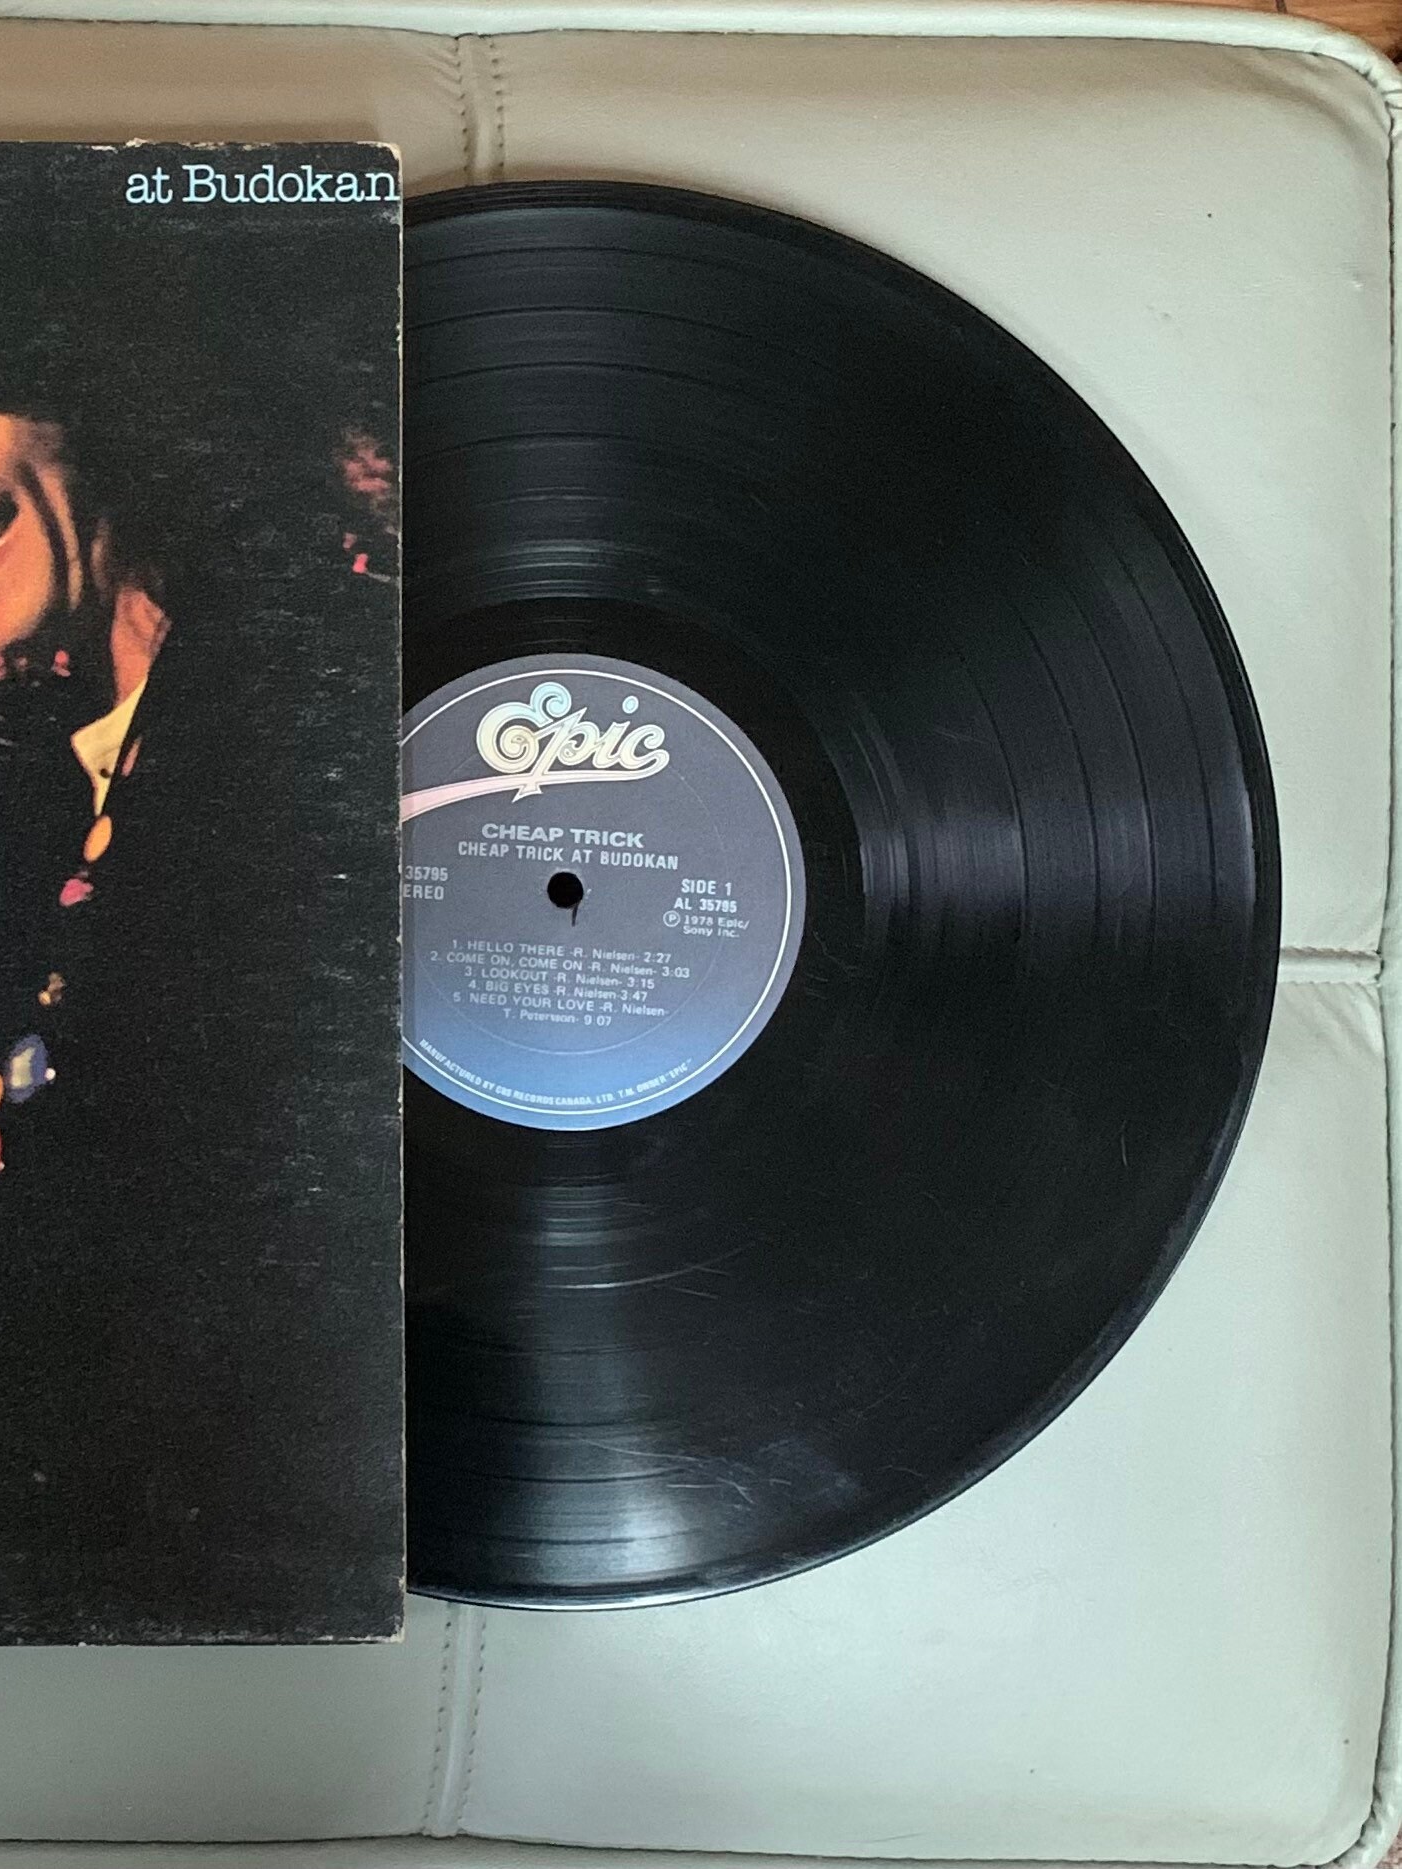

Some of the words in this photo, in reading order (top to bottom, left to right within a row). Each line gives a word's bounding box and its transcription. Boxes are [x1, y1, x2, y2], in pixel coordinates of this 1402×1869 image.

[125, 166, 174, 204] at
[181, 163, 401, 204] Budokan
[475, 681, 670, 803] Epic
[481, 822, 564, 842] CHEAP
[569, 827, 644, 848] TRICK
[458, 840, 509, 858] CHEAP
[515, 844, 564, 862] TRICK
[571, 848, 593, 864] AT
[600, 851, 679, 870] BUDOKAN
[404, 865, 449, 882] 35795
[681, 878, 717, 895] SIDE
[725, 882, 732, 896] 1
[674, 897, 693, 911] AL
[699, 898, 738, 914] 35795
[684, 914, 714, 927] 1978
[683, 925, 714, 937] Sony
[717, 928, 740, 938] Inc.
[467, 940, 514, 953] HELLO
[519, 943, 565, 957] THERE
[643, 951, 672, 964] 2:27
[446, 951, 486, 965] COME
[518, 956, 558, 970] COME
[562, 959, 583, 971] ON
[661, 966, 690, 979] 3:03
[481, 967, 548, 981] LOOKOUT
[626, 976, 655, 990] 3:15
[485, 980, 509, 993] BIG
[514, 982, 550, 996] EYES
[469, 992, 508, 1006] NEED
[512, 996, 552, 1009] YOUR
[557, 998, 595, 1012] LOVE
[502, 1008, 517, 1019] T.
[418, 1038, 484, 1086] MANUFACTURED
[482, 1081, 496, 1091] BY
[512, 1090, 554, 1106] RECORDS
